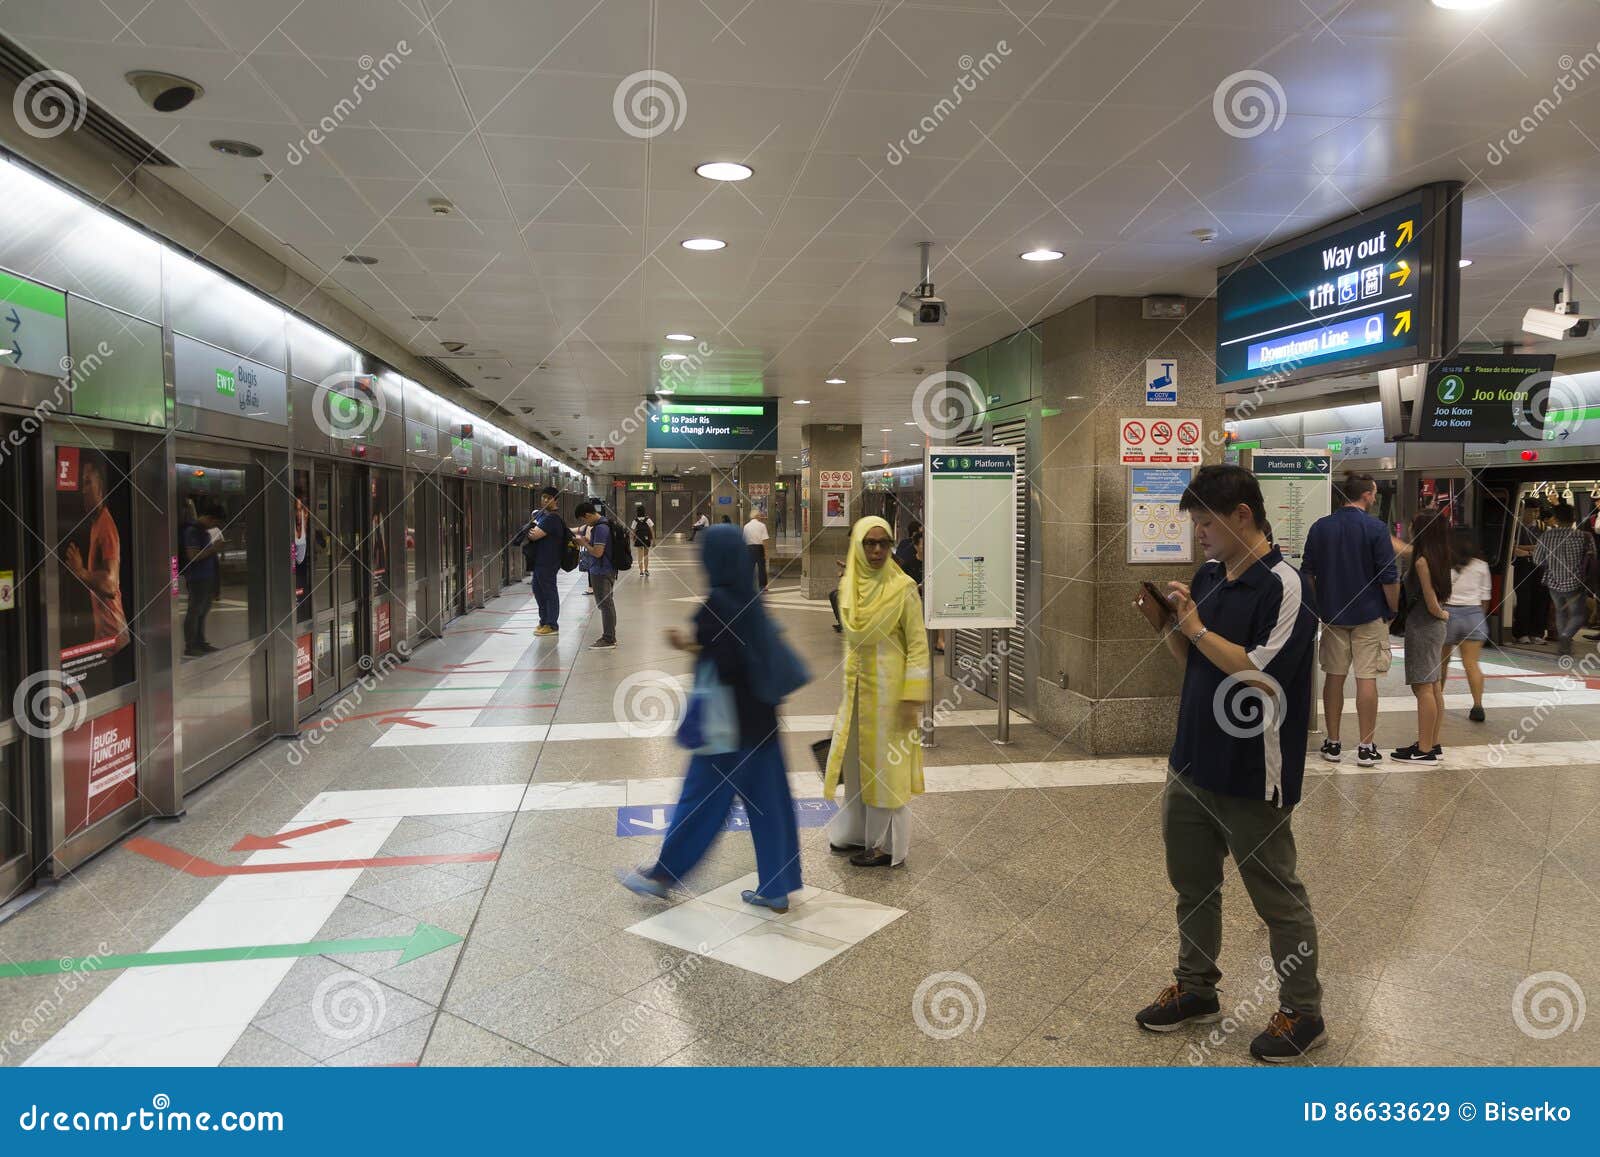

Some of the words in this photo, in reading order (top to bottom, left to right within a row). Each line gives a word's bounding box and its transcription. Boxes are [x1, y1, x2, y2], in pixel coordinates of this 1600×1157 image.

[1322, 245, 1354, 270] Way
[1358, 231, 1386, 258] out
[1309, 282, 1335, 310] Lift
[1260, 336, 1318, 363] Downtown
[1322, 330, 1349, 350] Line
[216, 372, 235, 392] EW12
[238, 366, 258, 388] Bugis
[1443, 379, 1457, 400] 2
[1472, 389, 1494, 400] Joo
[1498, 389, 1528, 400] Koon
[1434, 407, 1450, 416] Joo
[1452, 407, 1472, 416] Koon
[1514, 408, 1520, 416] 2
[680, 426, 704, 435] Changi
[705, 426, 730, 435] Airport
[1432, 419, 1448, 428] Joo
[1450, 419, 1471, 428] Koon
[1345, 436, 1361, 445] Bugis
[94, 728, 118, 750] BUGIS
[93, 736, 131, 768] JUNCTION
